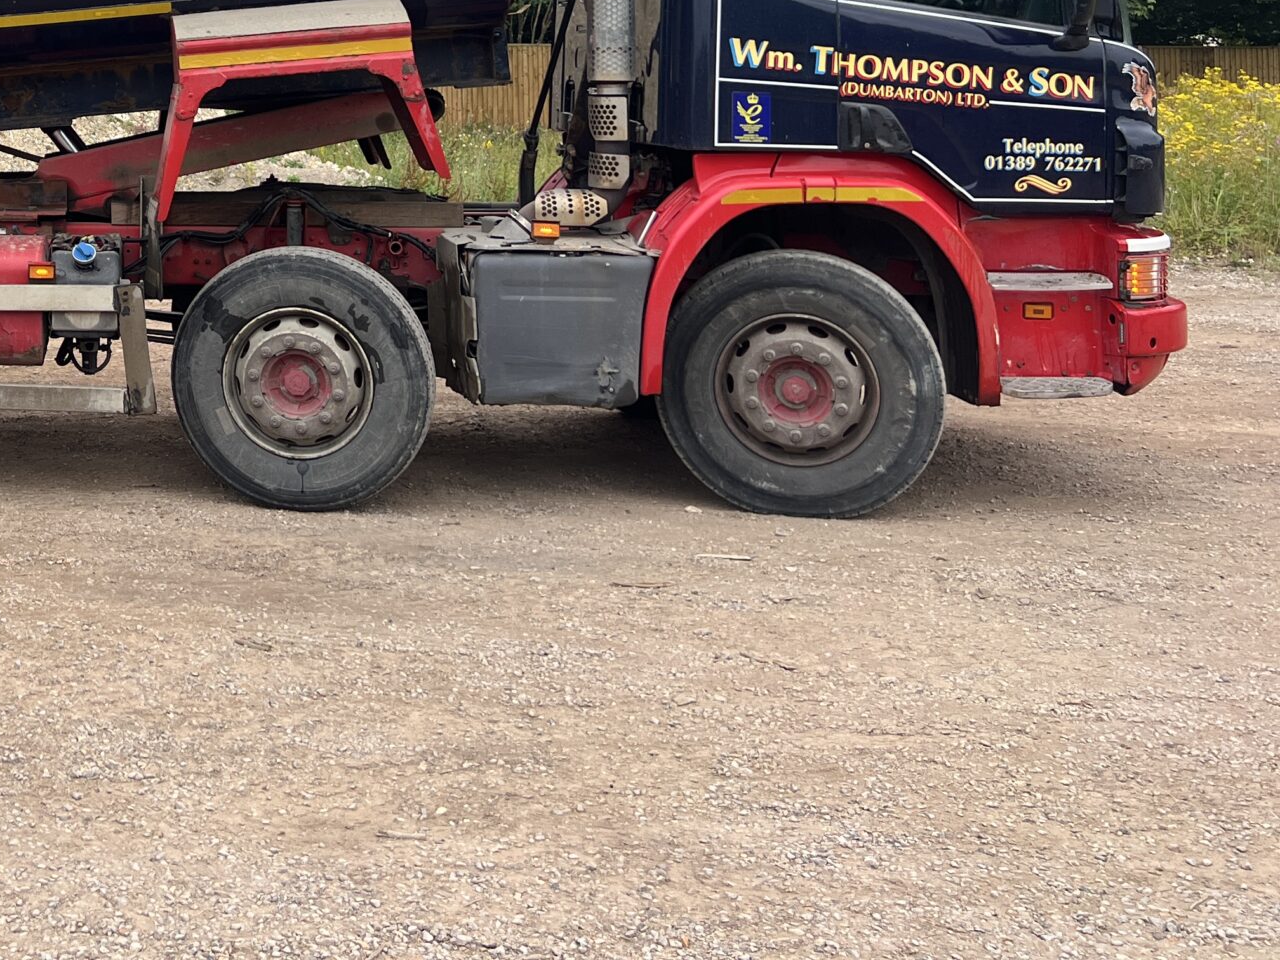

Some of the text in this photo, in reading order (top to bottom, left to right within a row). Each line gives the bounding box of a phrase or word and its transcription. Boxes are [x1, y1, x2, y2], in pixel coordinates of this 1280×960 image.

[729, 37, 1095, 101] Wm. THOMPSON & SON
[840, 81, 990, 109] (DUMBARTON) LTD.
[1002, 138, 1084, 158] Telephone
[984, 155, 1102, 172] 01389 762271
